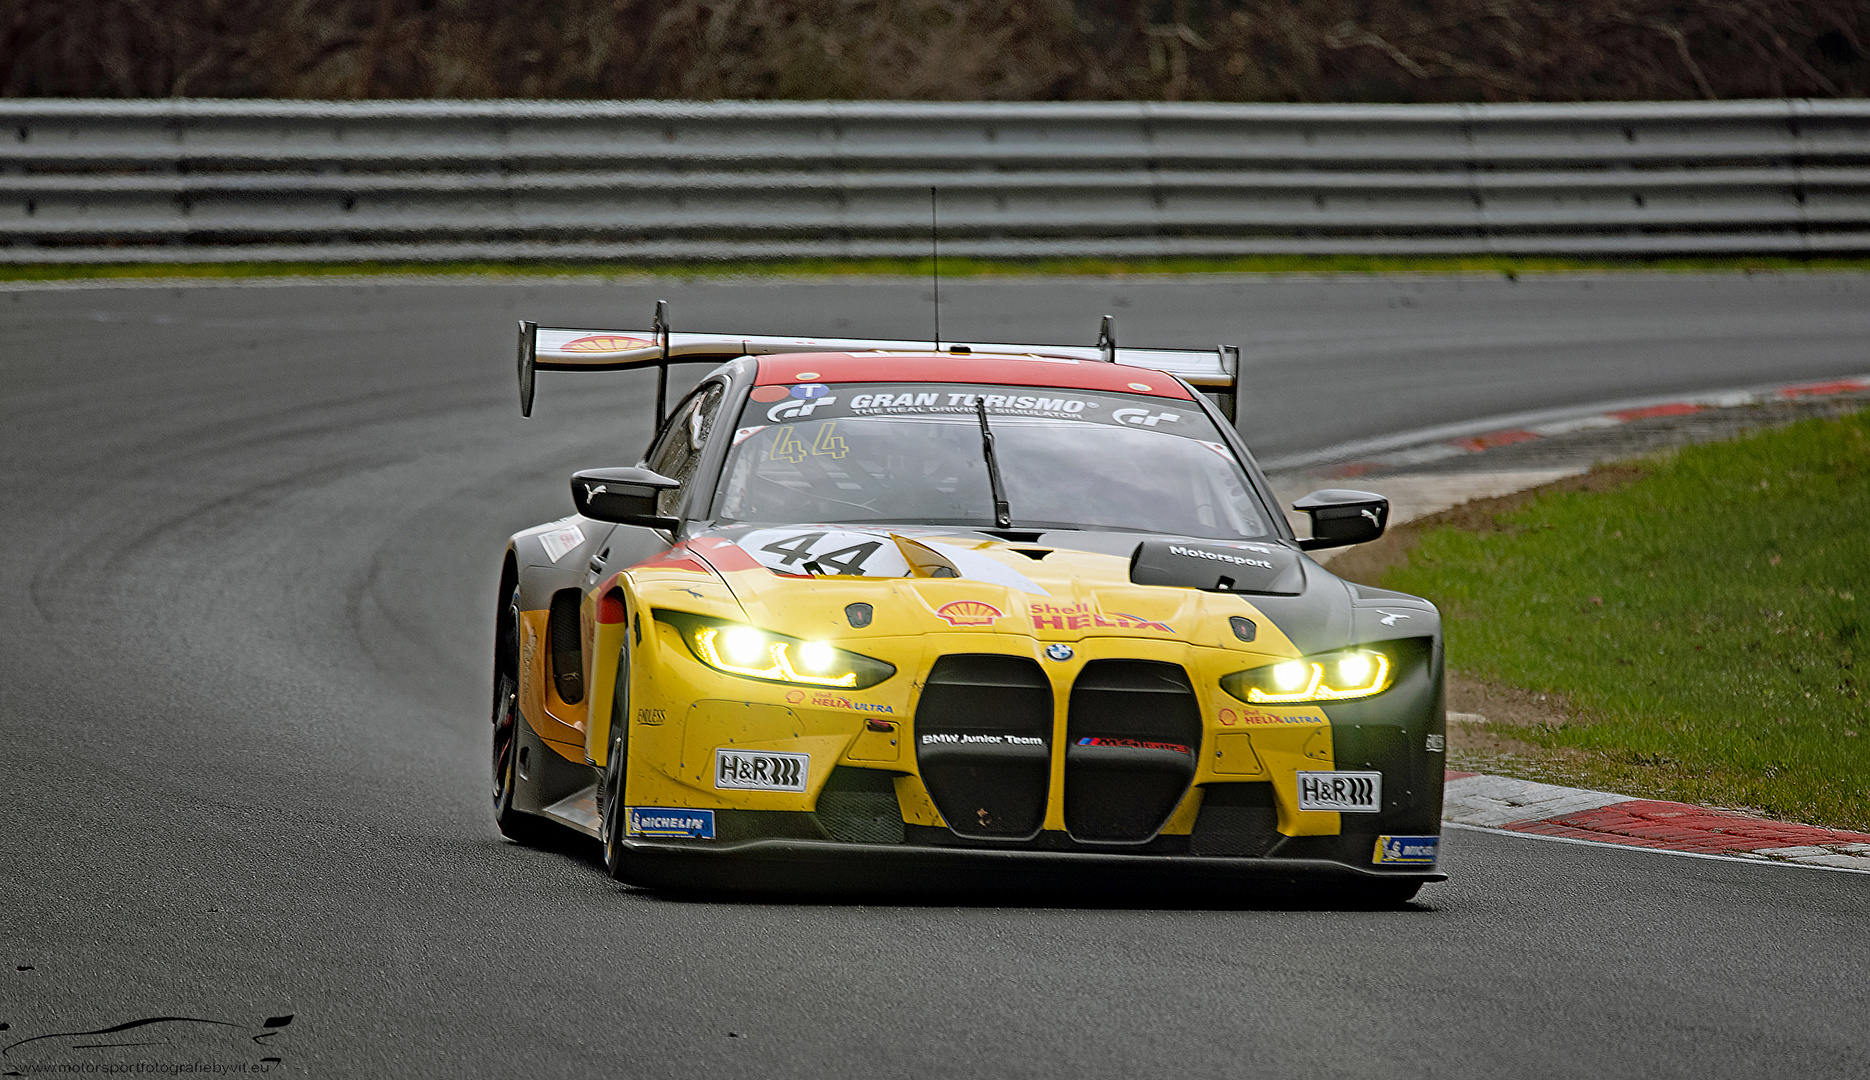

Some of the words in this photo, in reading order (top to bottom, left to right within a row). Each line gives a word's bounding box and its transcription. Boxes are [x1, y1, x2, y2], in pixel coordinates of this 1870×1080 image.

[850, 393, 939, 409] GRAN
[886, 406, 925, 414] REAL
[995, 407, 1083, 420] SIMULATOR
[770, 422, 849, 463] 44
[761, 532, 884, 576] 44
[1169, 545, 1272, 569] Motorsport
[1031, 603, 1089, 615] Shell
[1031, 613, 1174, 633] HELIX
[811, 697, 853, 710] HELIX
[854, 702, 894, 714] ULTRA
[1243, 714, 1284, 724] HELIX
[1283, 716, 1322, 724] ULTRA
[922, 734, 959, 744] BMW
[960, 734, 1003, 744] Junior
[1004, 735, 1043, 745] Team
[721, 754, 769, 781] H&R
[1303, 777, 1347, 802] H&R
[641, 816, 704, 830] MICHELIN
